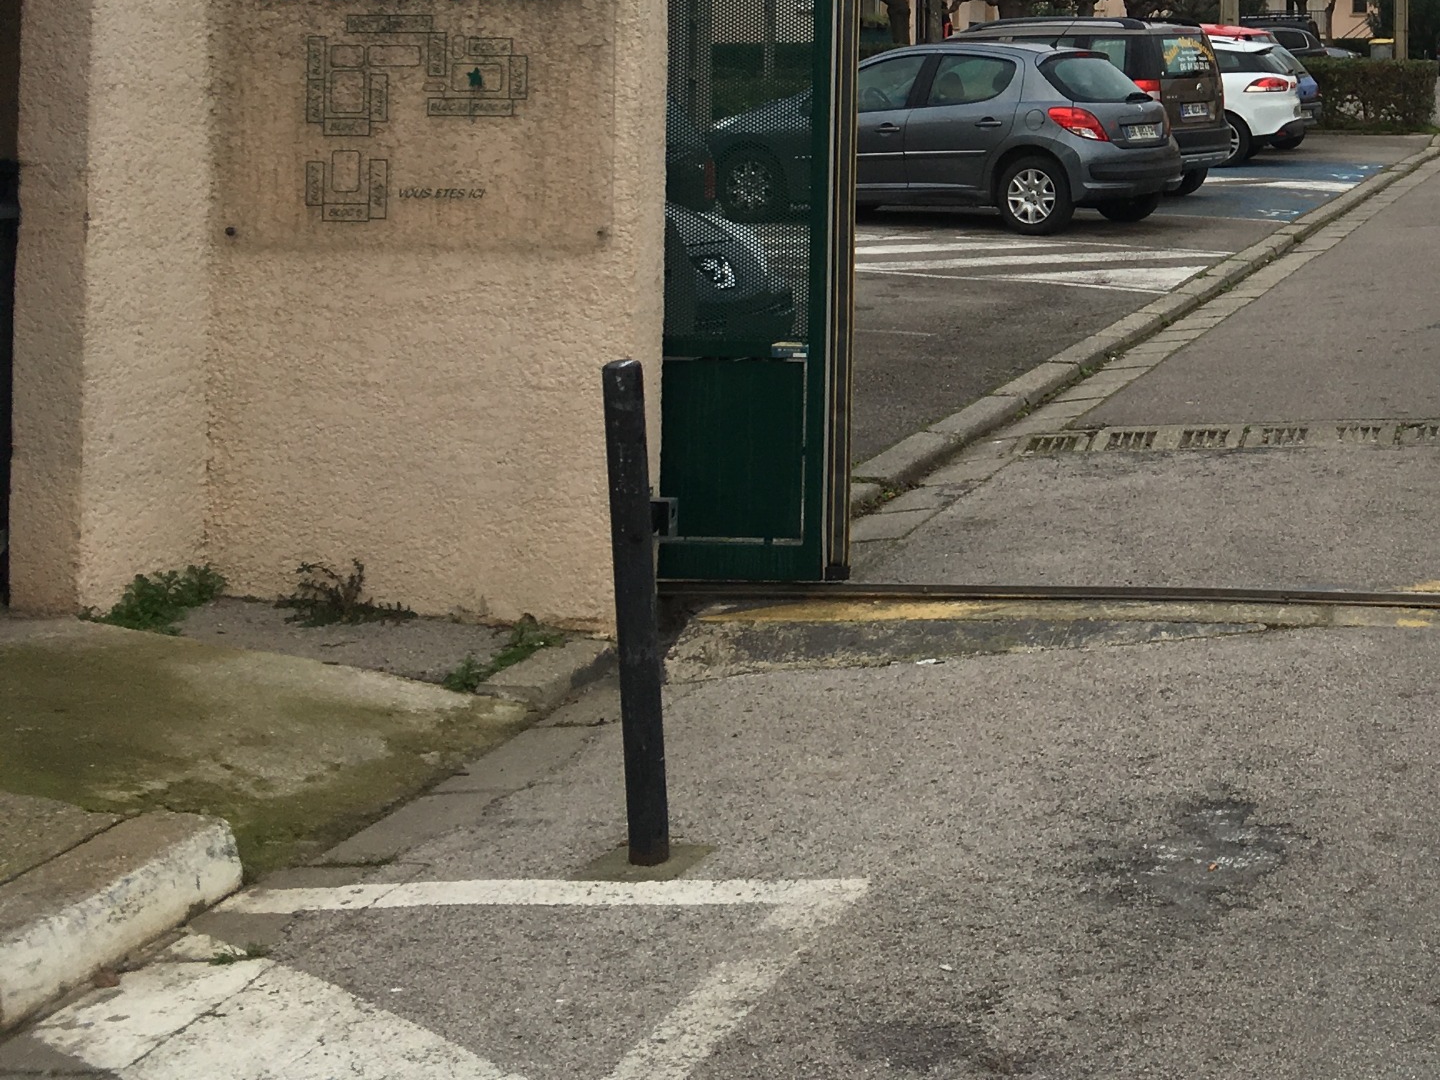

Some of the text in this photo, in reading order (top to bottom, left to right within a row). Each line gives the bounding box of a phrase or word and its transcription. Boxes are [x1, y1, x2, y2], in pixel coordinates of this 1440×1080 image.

[399, 188, 486, 199] VOUS ETES ICI
